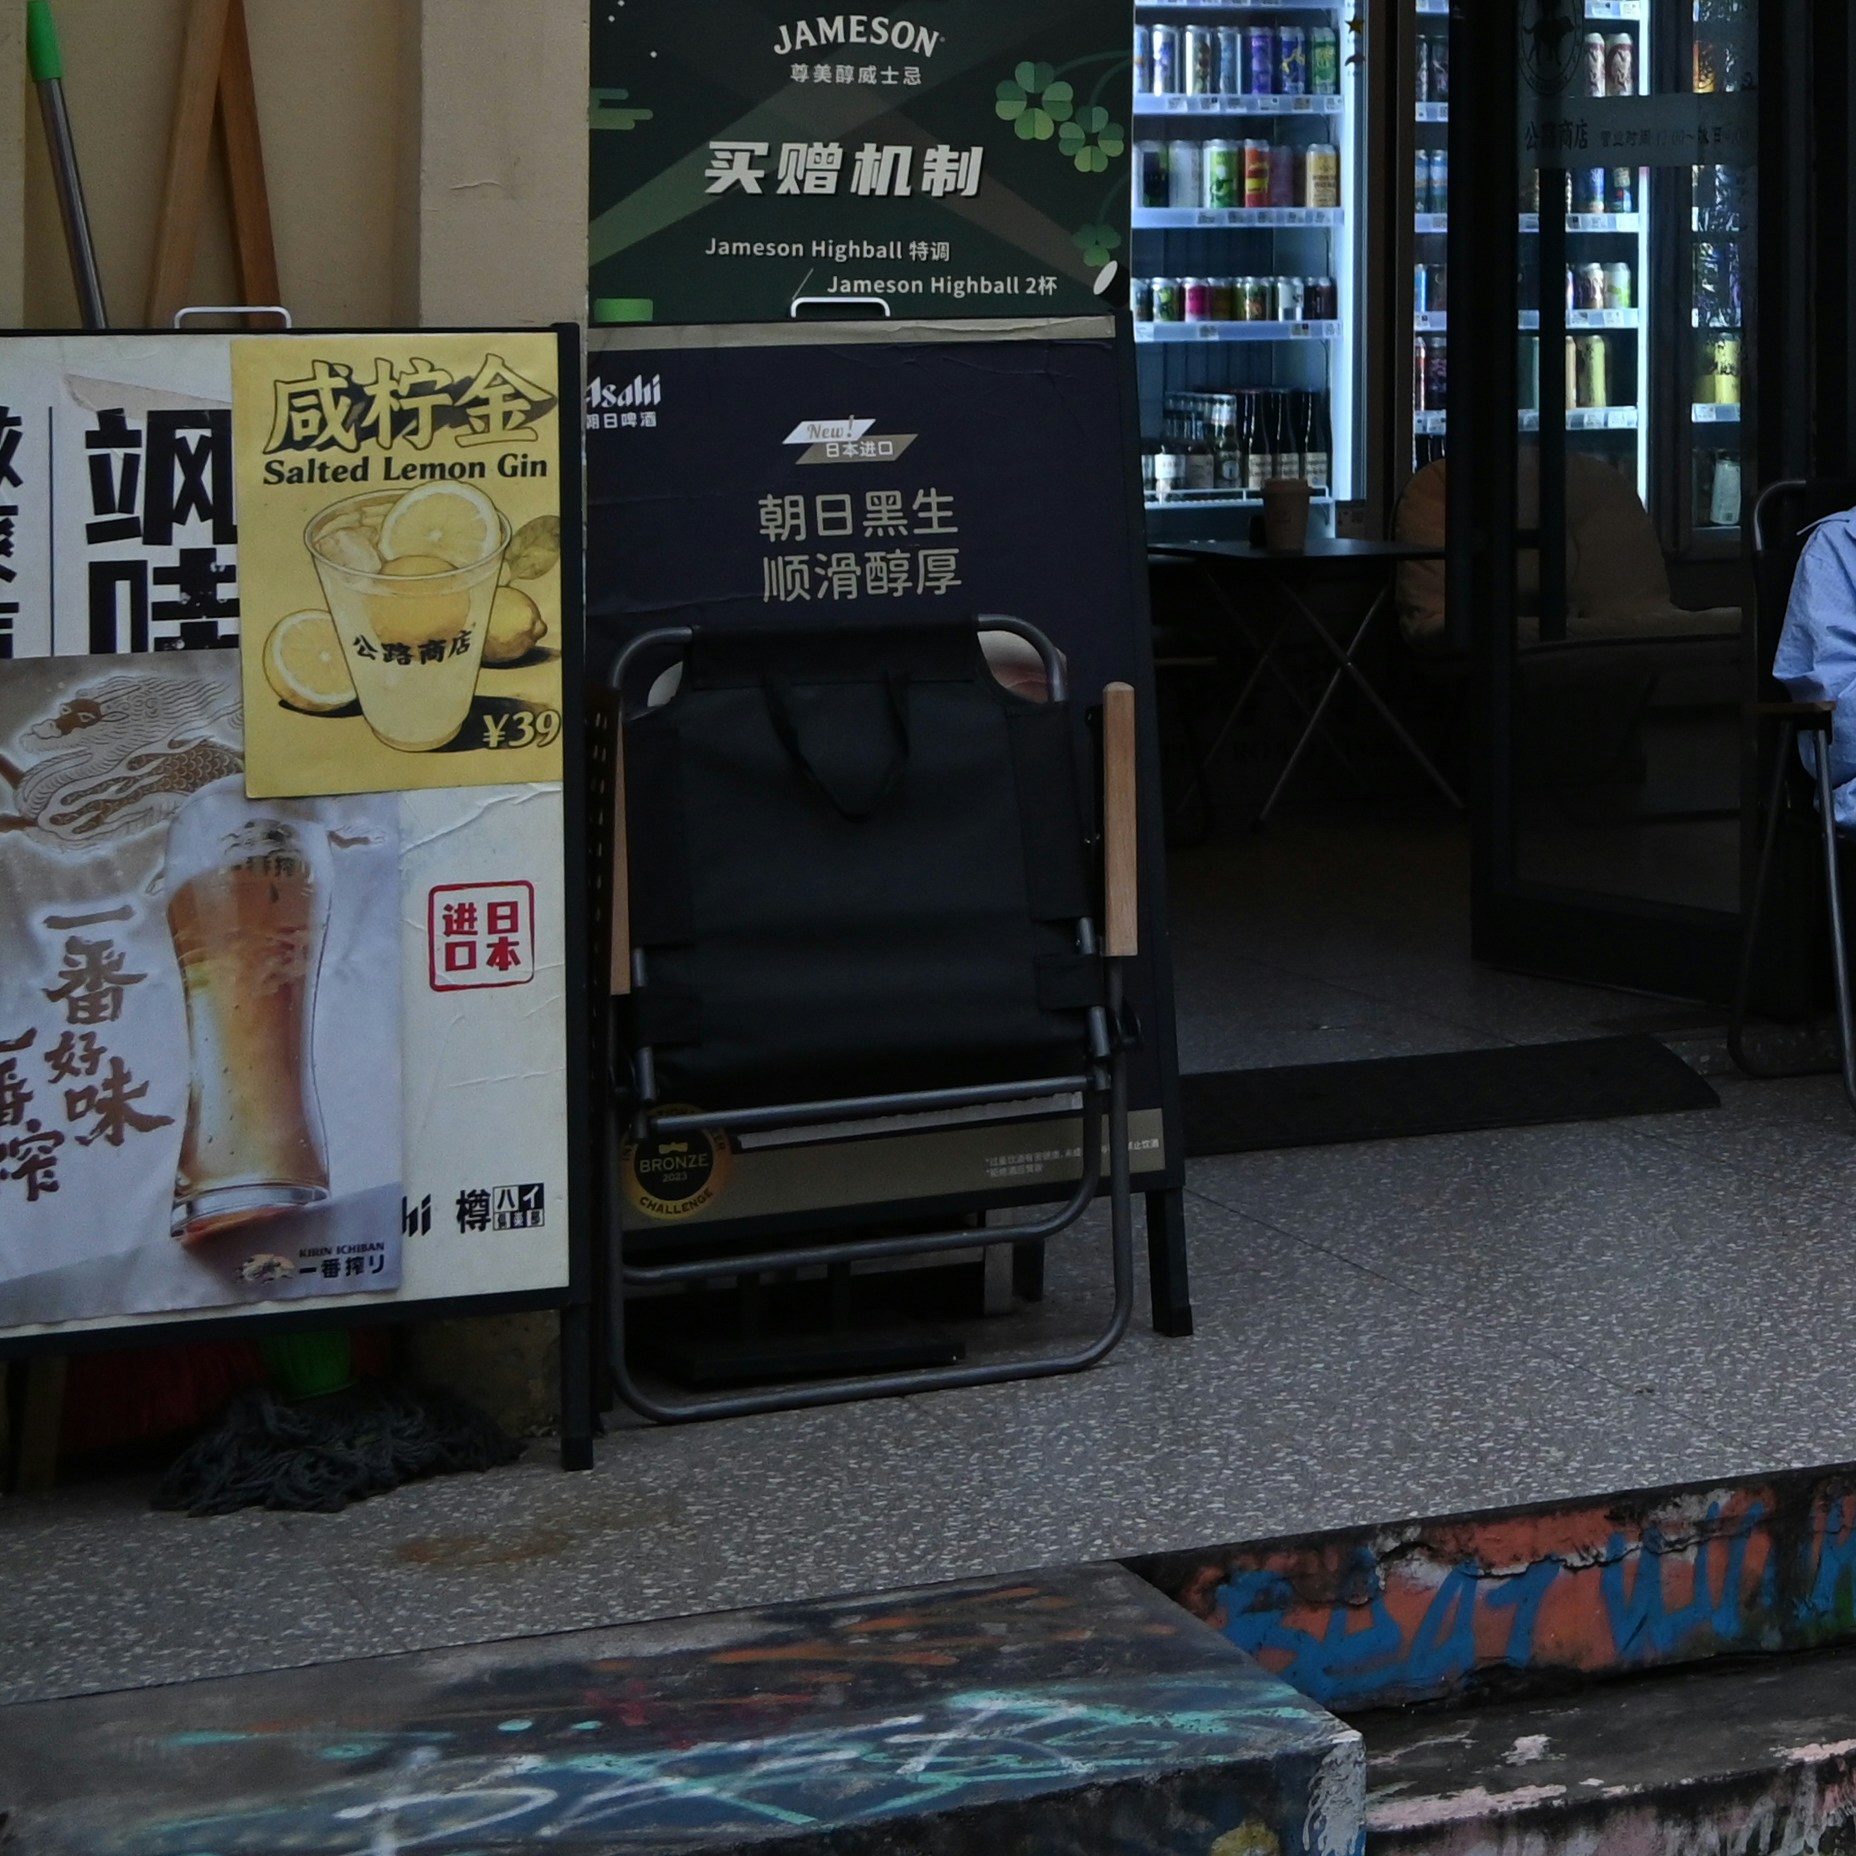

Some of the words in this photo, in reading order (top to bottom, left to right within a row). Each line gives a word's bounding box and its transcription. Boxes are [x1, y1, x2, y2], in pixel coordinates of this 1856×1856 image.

[772, 14, 938, 58] JAMESON
[789, 63, 923, 87] 尊美醇威士忌
[703, 140, 985, 198] 买赠机制
[705, 237, 804, 258] Jameson
[810, 239, 902, 262] Highball
[908, 240, 951, 263] 特调
[826, 274, 926, 295] Jameson
[930, 275, 1020, 299] Highball
[1025, 275, 1059, 296] 2杯
[262, 352, 558, 457] 咸柠金
[586, 373, 662, 409] Asahi
[806, 414, 856, 441] New!
[825, 441, 894, 459] 日本进口
[263, 456, 369, 486] Salted
[383, 454, 486, 482] Lemon
[497, 452, 548, 480] Gin
[757, 487, 959, 543] 朝日黑生
[762, 547, 963, 604] 顺滑醇厚
[352, 627, 474, 665] 公路商店
[482, 710, 561, 749] ¥39
[42, 905, 175, 1147] 一番好味
[640, 1152, 710, 1174] BRONZE
[639, 1186, 714, 1215] CHALLENGE
[335, 1242, 385, 1256] ICHIBAN
